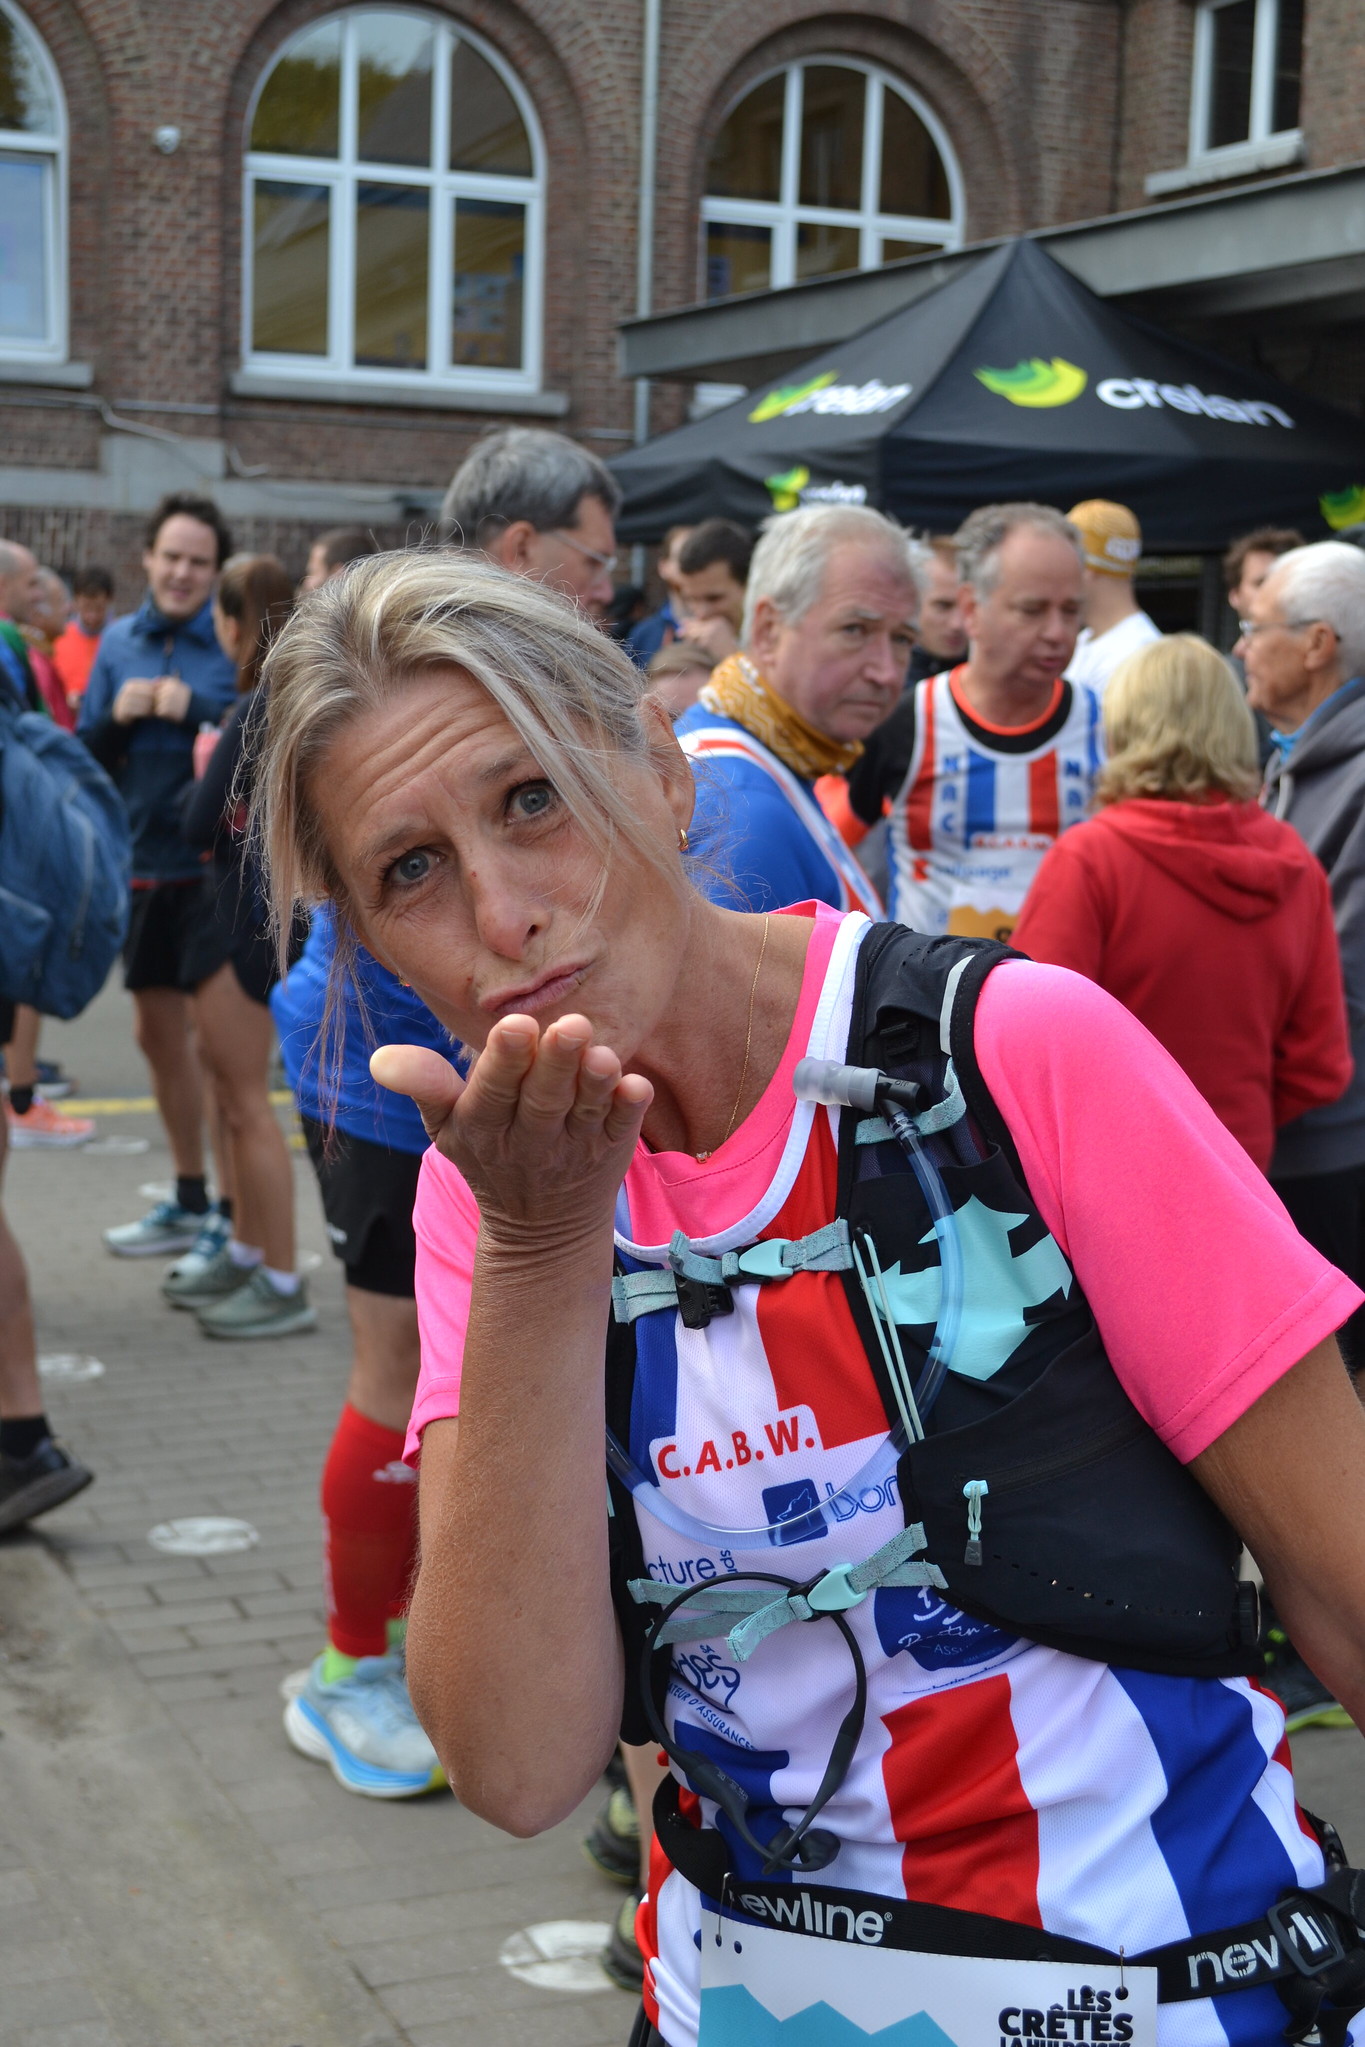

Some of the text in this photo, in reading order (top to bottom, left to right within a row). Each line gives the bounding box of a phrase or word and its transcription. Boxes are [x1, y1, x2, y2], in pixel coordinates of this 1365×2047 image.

[1096, 377, 1295, 429] crelan
[657, 1416, 815, 1479] C.A.B.W.
[998, 2003, 1133, 2042] CRÊTES
[1067, 1989, 1112, 2012] LES
